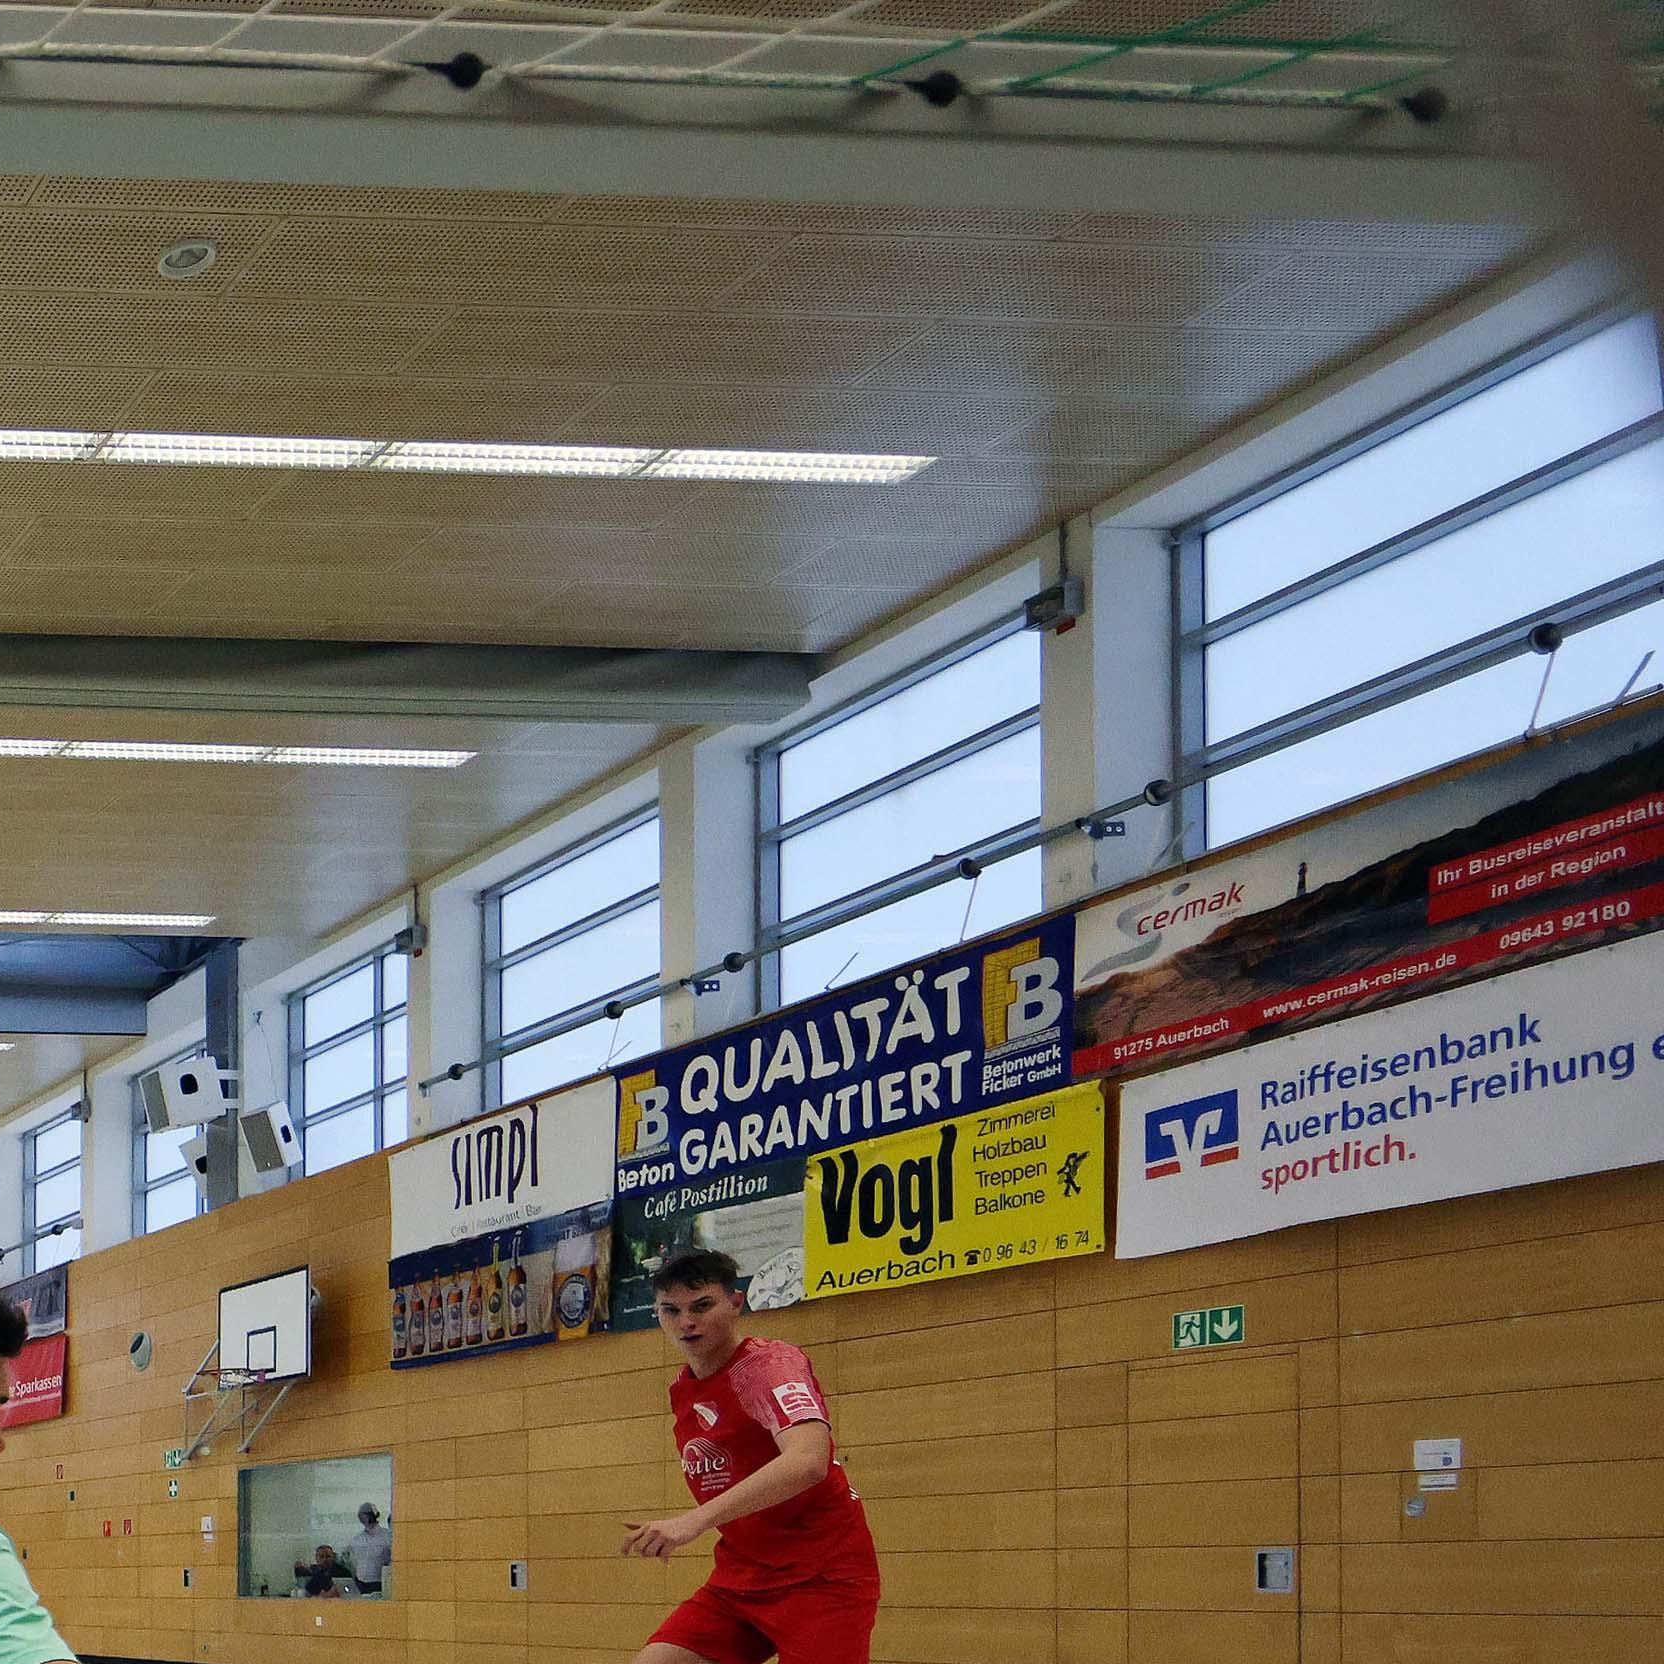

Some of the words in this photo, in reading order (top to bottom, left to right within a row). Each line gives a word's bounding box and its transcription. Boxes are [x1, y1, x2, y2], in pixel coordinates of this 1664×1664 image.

[1437, 866, 1463, 886] Ihr
[1491, 881, 1508, 899] in
[1515, 870, 1545, 892] der
[1550, 844, 1626, 878] Region
[1137, 881, 1246, 936] cermak
[1113, 1037, 1153, 1061] 91275
[1155, 1015, 1230, 1048] Auerbach
[1262, 952, 1457, 1020] www.cermak-reisen.de
[1499, 920, 1554, 950] 09643
[1562, 900, 1631, 932] 92180
[679, 966, 971, 1115] QUALITÄT
[983, 1043, 1061, 1080] Betonwerk
[1260, 1012, 1542, 1111] Raiffeisenbank
[982, 1073, 1024, 1096] Ficker
[1027, 1063, 1062, 1083] GmbH
[1260, 1041, 1636, 1151] Auerbach-Freihung
[679, 1049, 972, 1176] GARANTIERT
[977, 1101, 1056, 1137] Zimmerei
[973, 1134, 1047, 1162] Holzbau
[1261, 1133, 1417, 1194] sportlich.
[618, 1161, 675, 1193] Beton
[644, 1190, 677, 1221] Café
[679, 1173, 768, 1210] Postillion
[817, 1123, 957, 1256] Vogl
[975, 1161, 1048, 1189] Treppen
[975, 1187, 1045, 1216] Balkone
[816, 1249, 955, 1292] Auerbach
[16, 1374, 62, 1398] Sparkassen
